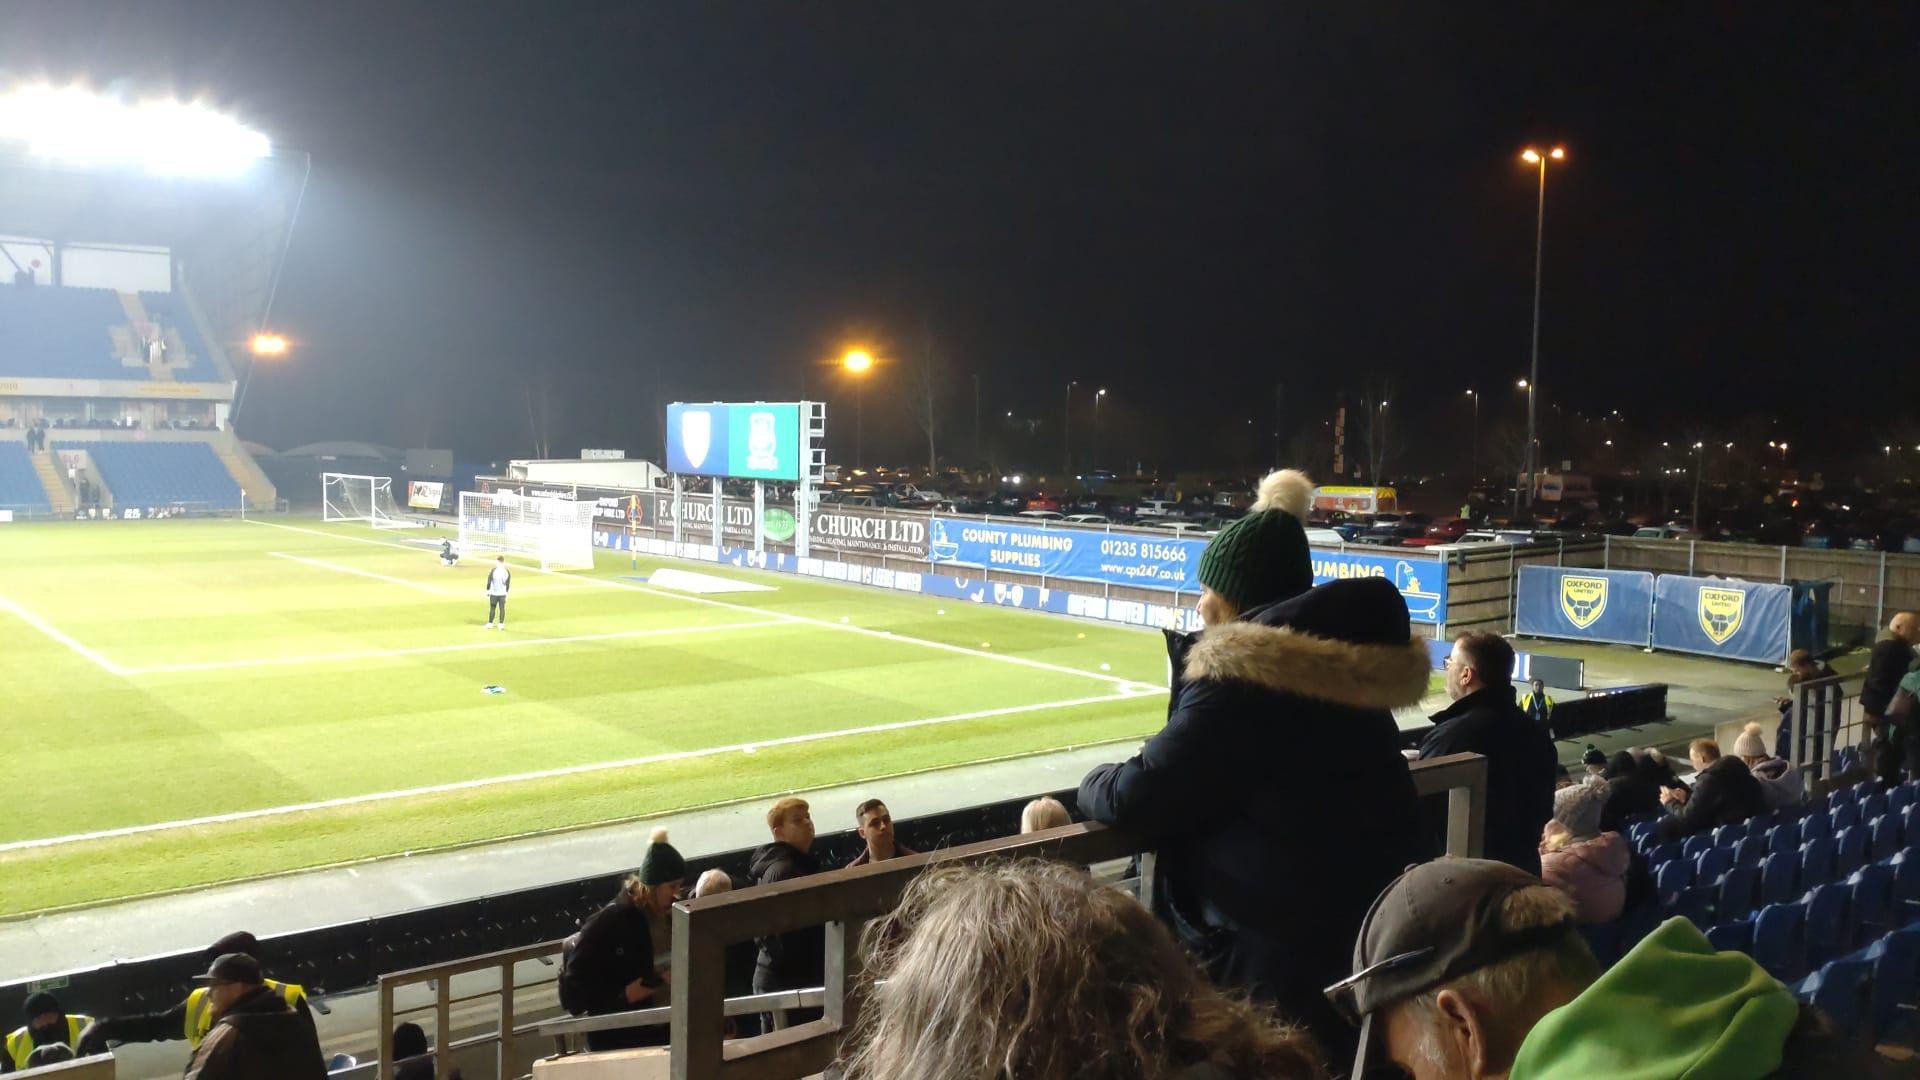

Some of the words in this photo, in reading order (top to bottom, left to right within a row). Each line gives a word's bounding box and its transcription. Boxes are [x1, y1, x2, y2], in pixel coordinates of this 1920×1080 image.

[727, 506, 753, 526] LTD
[817, 514, 887, 540] CHURCH
[889, 519, 925, 543] LTD
[962, 528, 1008, 545] COUNTY
[1010, 533, 1073, 552] PLUMBING
[990, 549, 1041, 568] SUPPLIES
[1100, 539, 1137, 557] 01235
[1140, 543, 1186, 562] 815666
[1100, 562, 1186, 582] www.cps247.co.uk
[1311, 560, 1385, 579] UMBING
[1566, 580, 1602, 589] OXFORD
[1705, 592, 1740, 603] OXFORD
